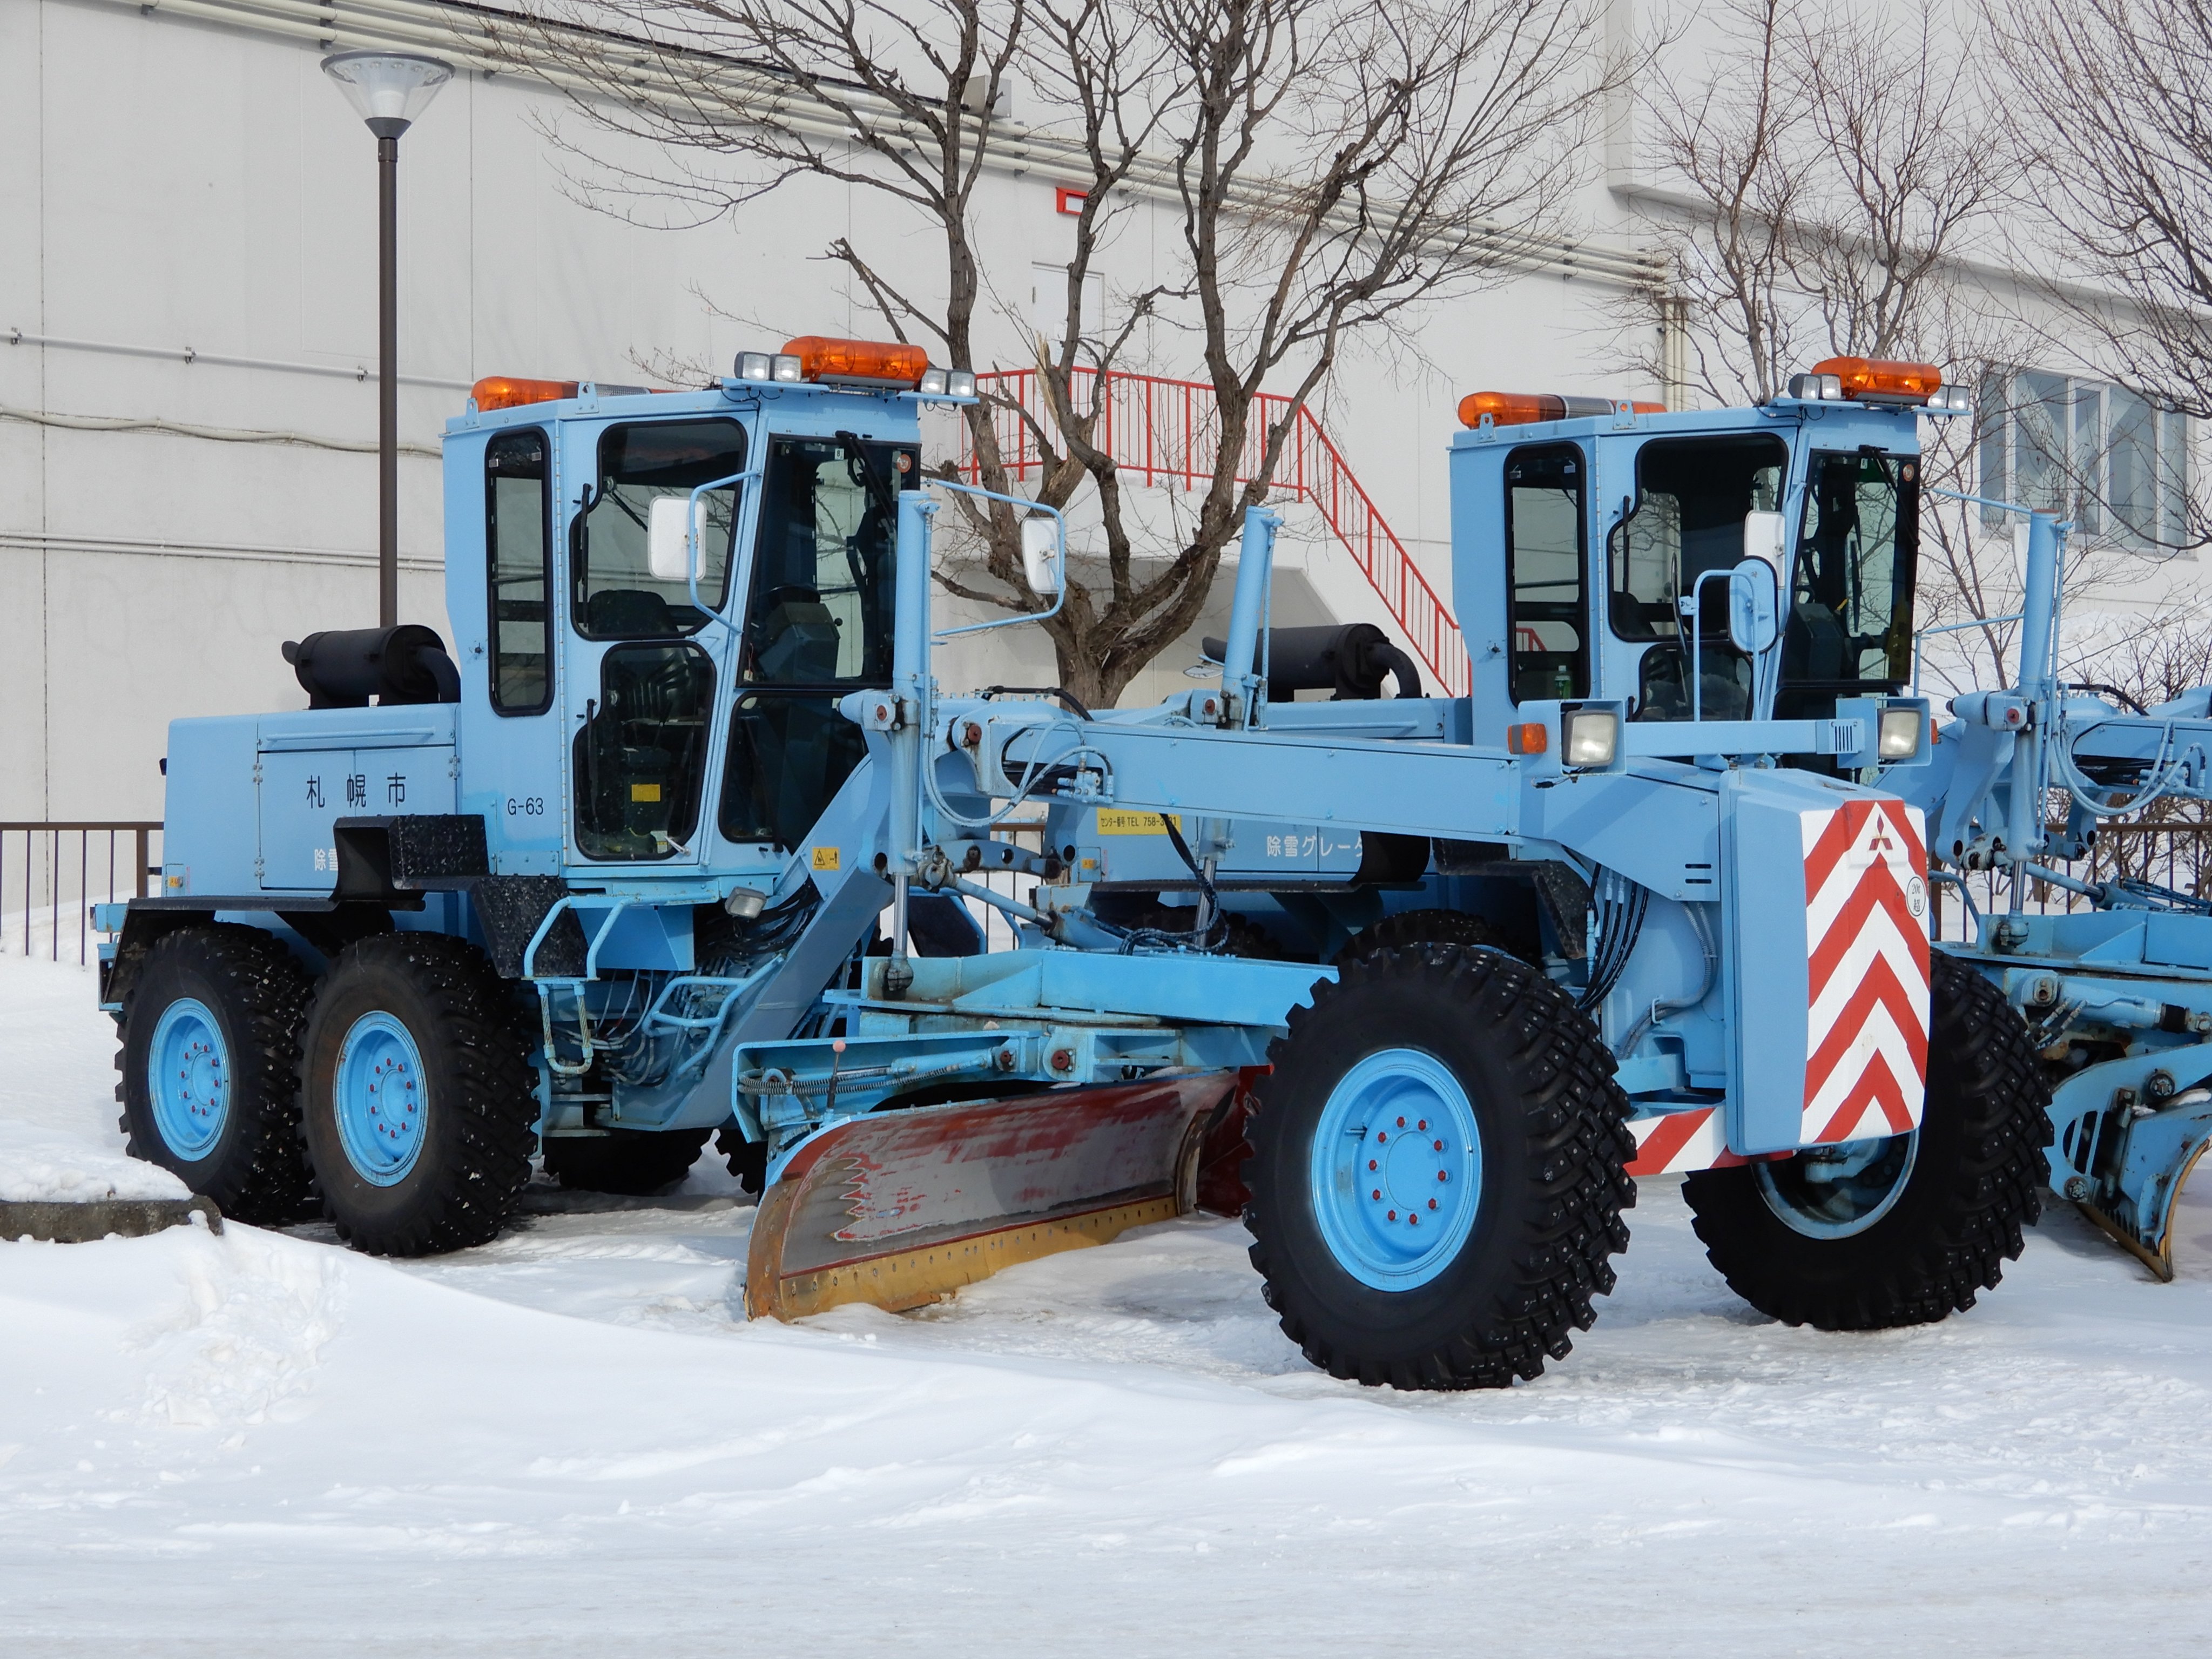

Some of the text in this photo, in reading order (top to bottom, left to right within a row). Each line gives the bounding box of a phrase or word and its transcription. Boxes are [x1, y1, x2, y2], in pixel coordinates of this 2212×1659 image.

[306, 772, 407, 809] 札幌市
[508, 797, 544, 815] G-63
[1101, 817, 1176, 827] センター番号 TEL 758-31
[1912, 884, 1920, 894] 20t
[1913, 899, 1920, 912] 超
